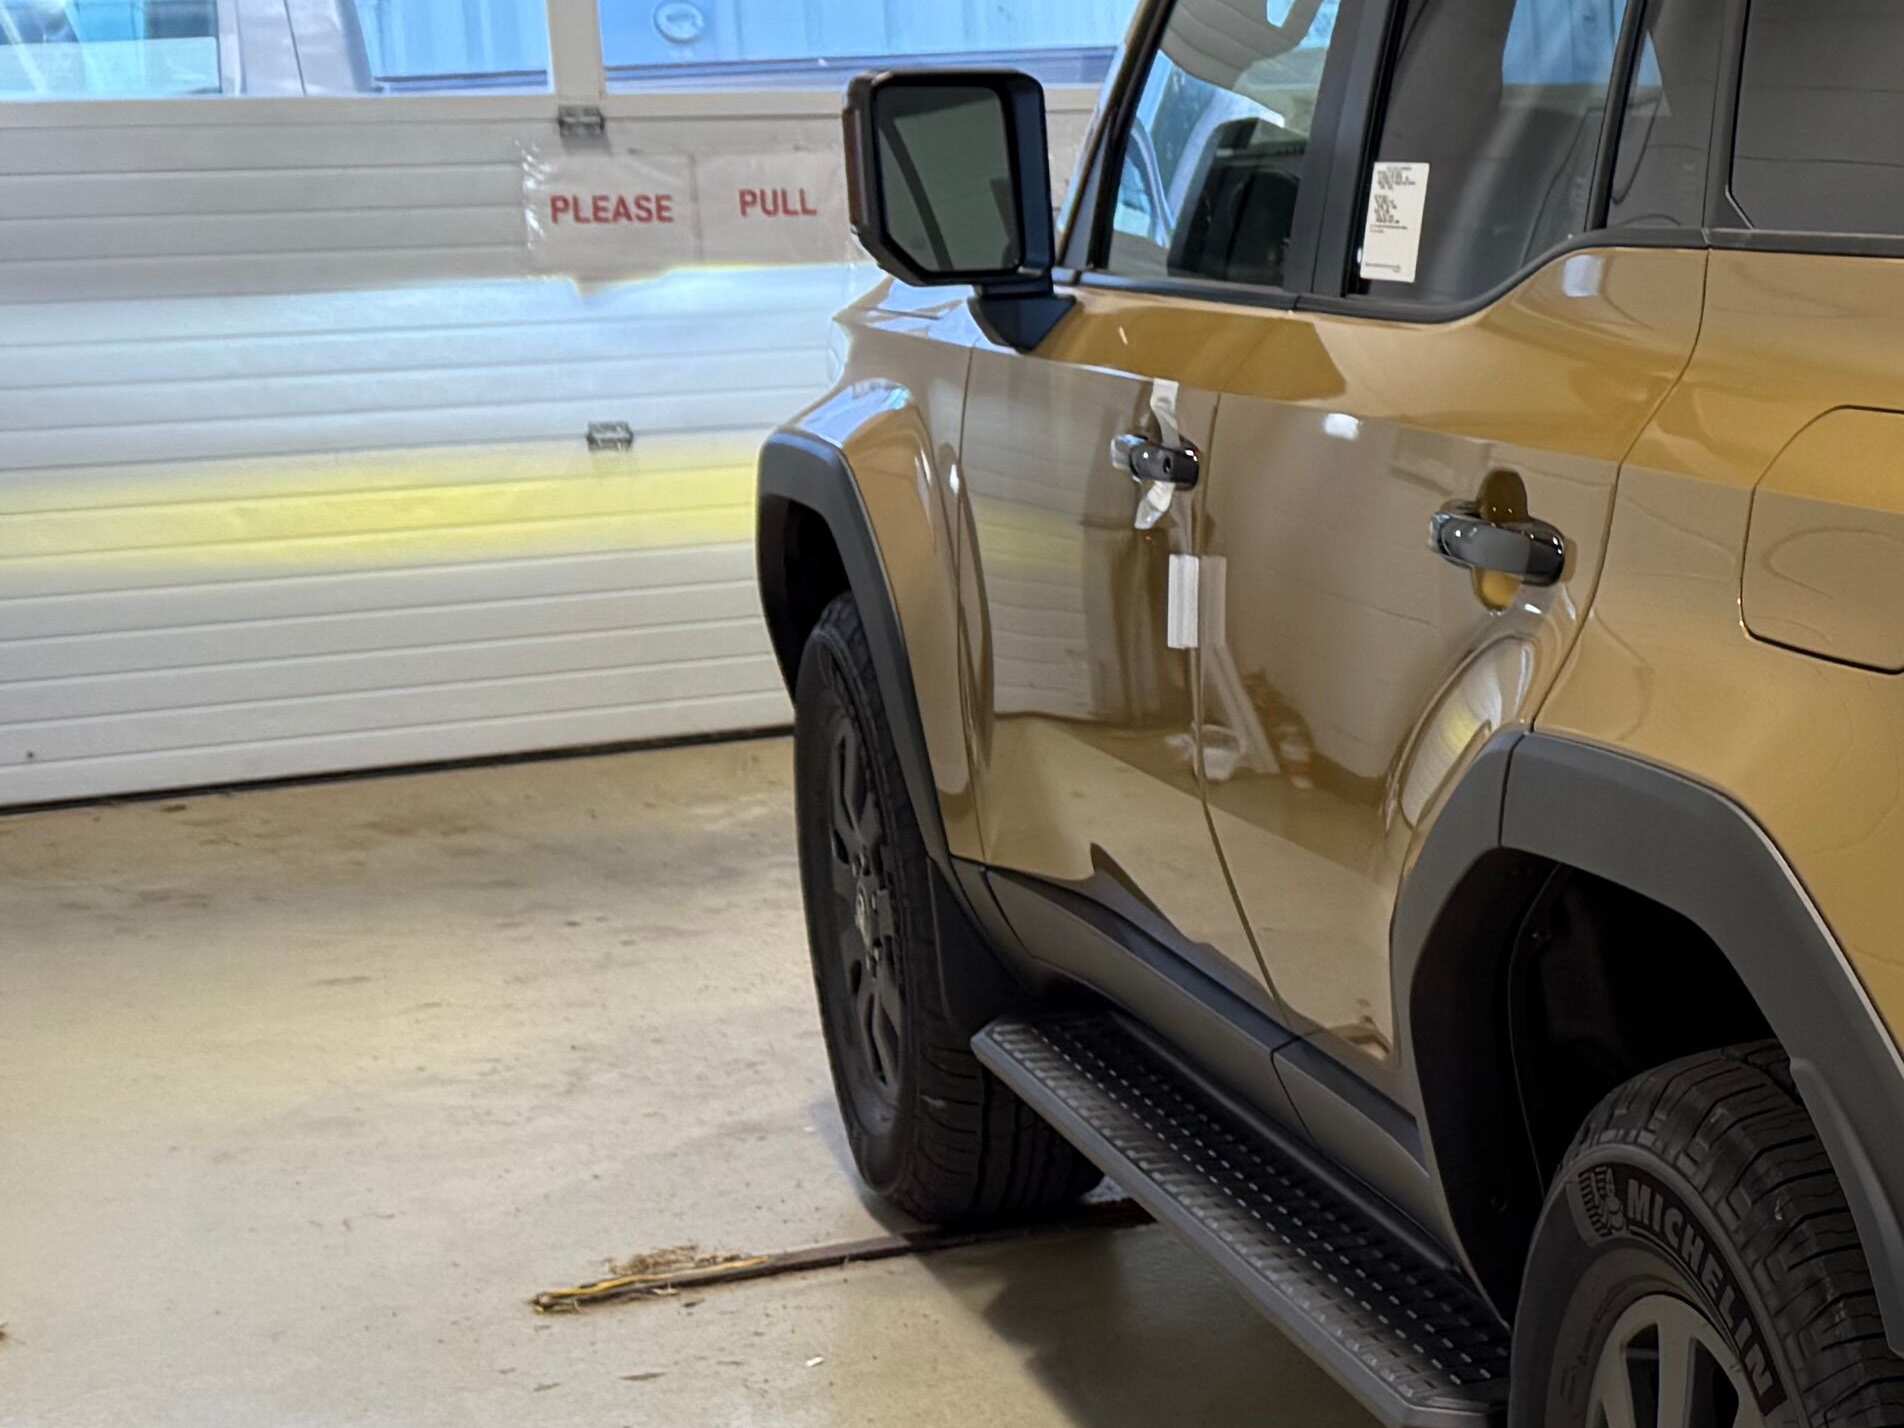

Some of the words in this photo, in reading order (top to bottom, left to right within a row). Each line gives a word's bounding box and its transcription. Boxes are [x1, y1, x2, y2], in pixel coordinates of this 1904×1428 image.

[550, 194, 674, 225] PLEASE
[738, 188, 817, 218] PULL
[1626, 1177, 1774, 1397] MICHELIN
